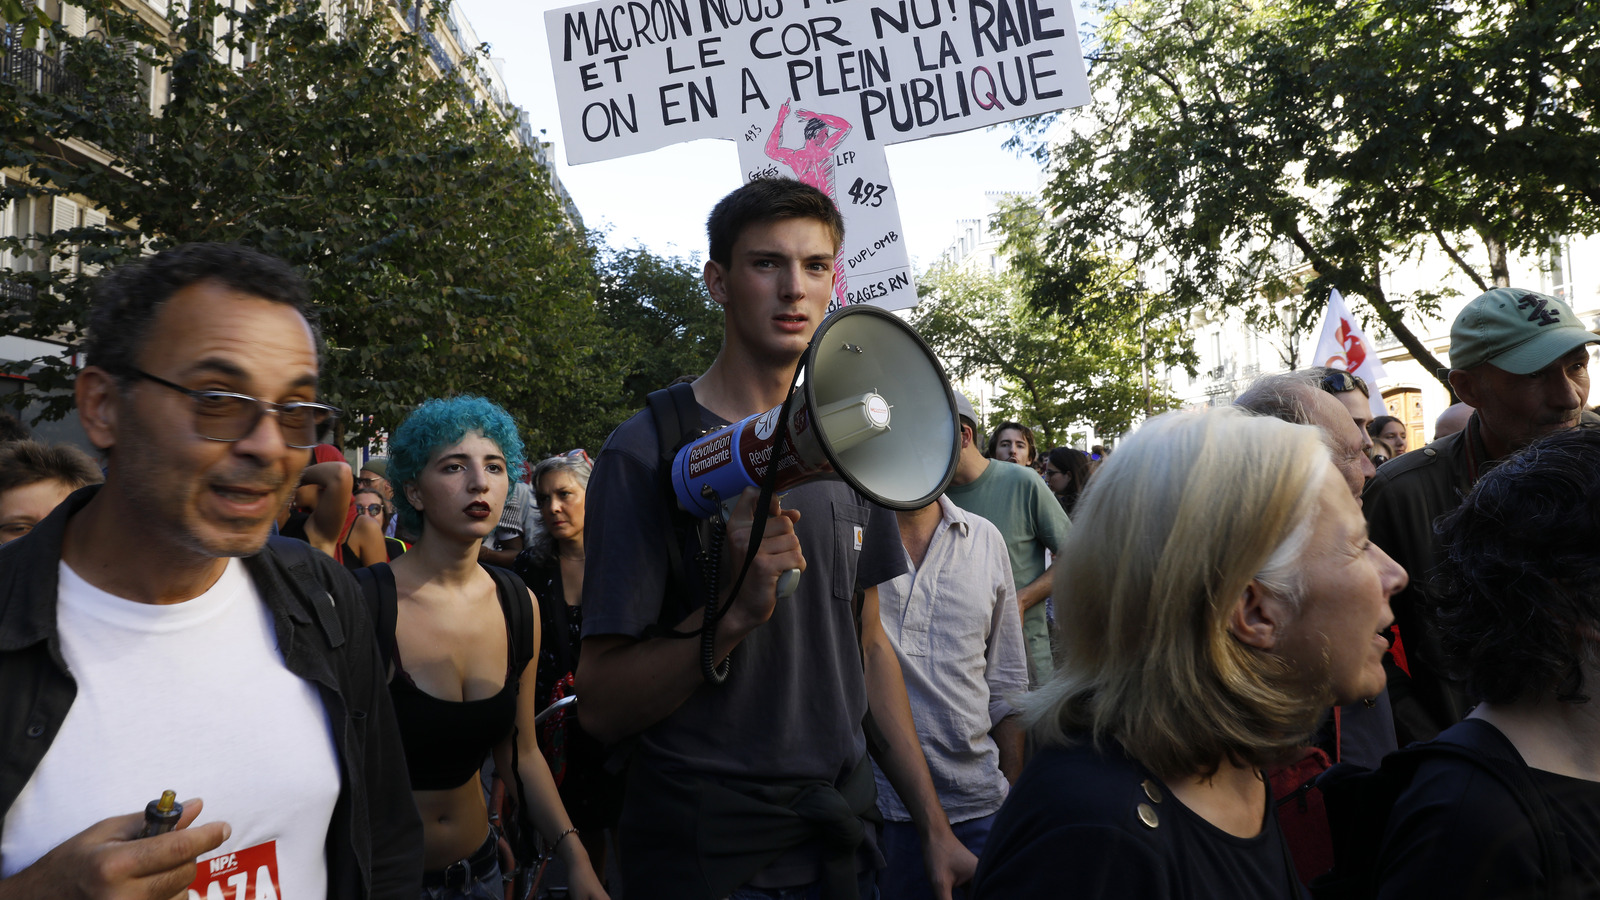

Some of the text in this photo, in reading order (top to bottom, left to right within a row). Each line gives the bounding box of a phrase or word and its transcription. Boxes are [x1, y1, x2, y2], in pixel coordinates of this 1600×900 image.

[564, 0, 693, 62] MACRON
[579, 54, 629, 92] ET
[665, 37, 726, 75] LE
[749, 17, 853, 60] COR
[581, 0, 1065, 143] ON EN A PLEIN LA RAIE
[859, 50, 1064, 141] PUBLIQUE
[836, 151, 856, 167] LFP
[847, 230, 899, 269] DUPLOMB
[888, 271, 909, 292] RN
[689, 435, 731, 462] Révolution
[690, 448, 730, 475] Permanente
